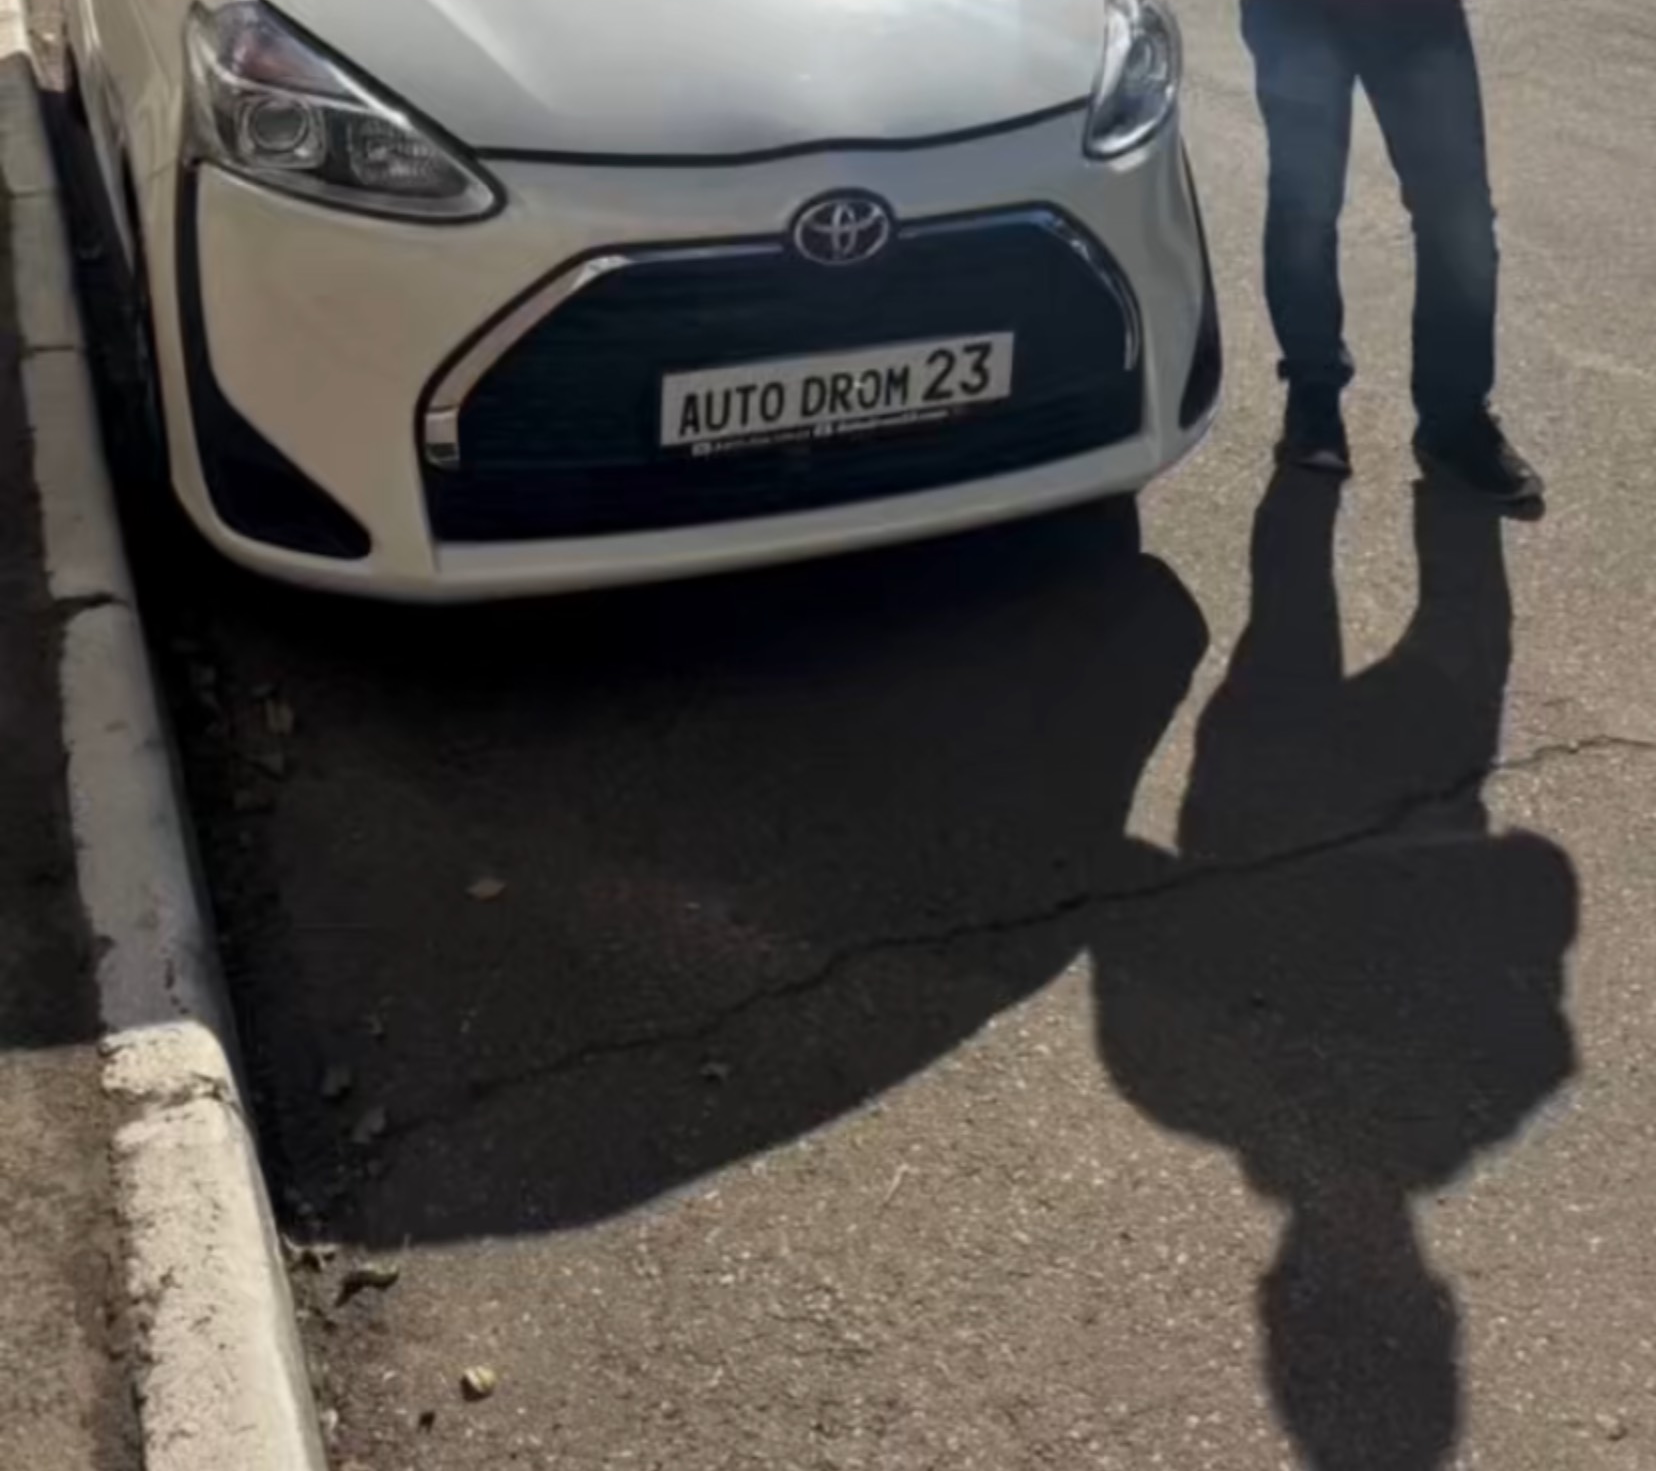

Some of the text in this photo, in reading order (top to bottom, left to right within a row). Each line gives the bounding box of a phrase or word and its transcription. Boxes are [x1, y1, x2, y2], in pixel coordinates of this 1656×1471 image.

[677, 341, 994, 438] AUTO DROM 23
